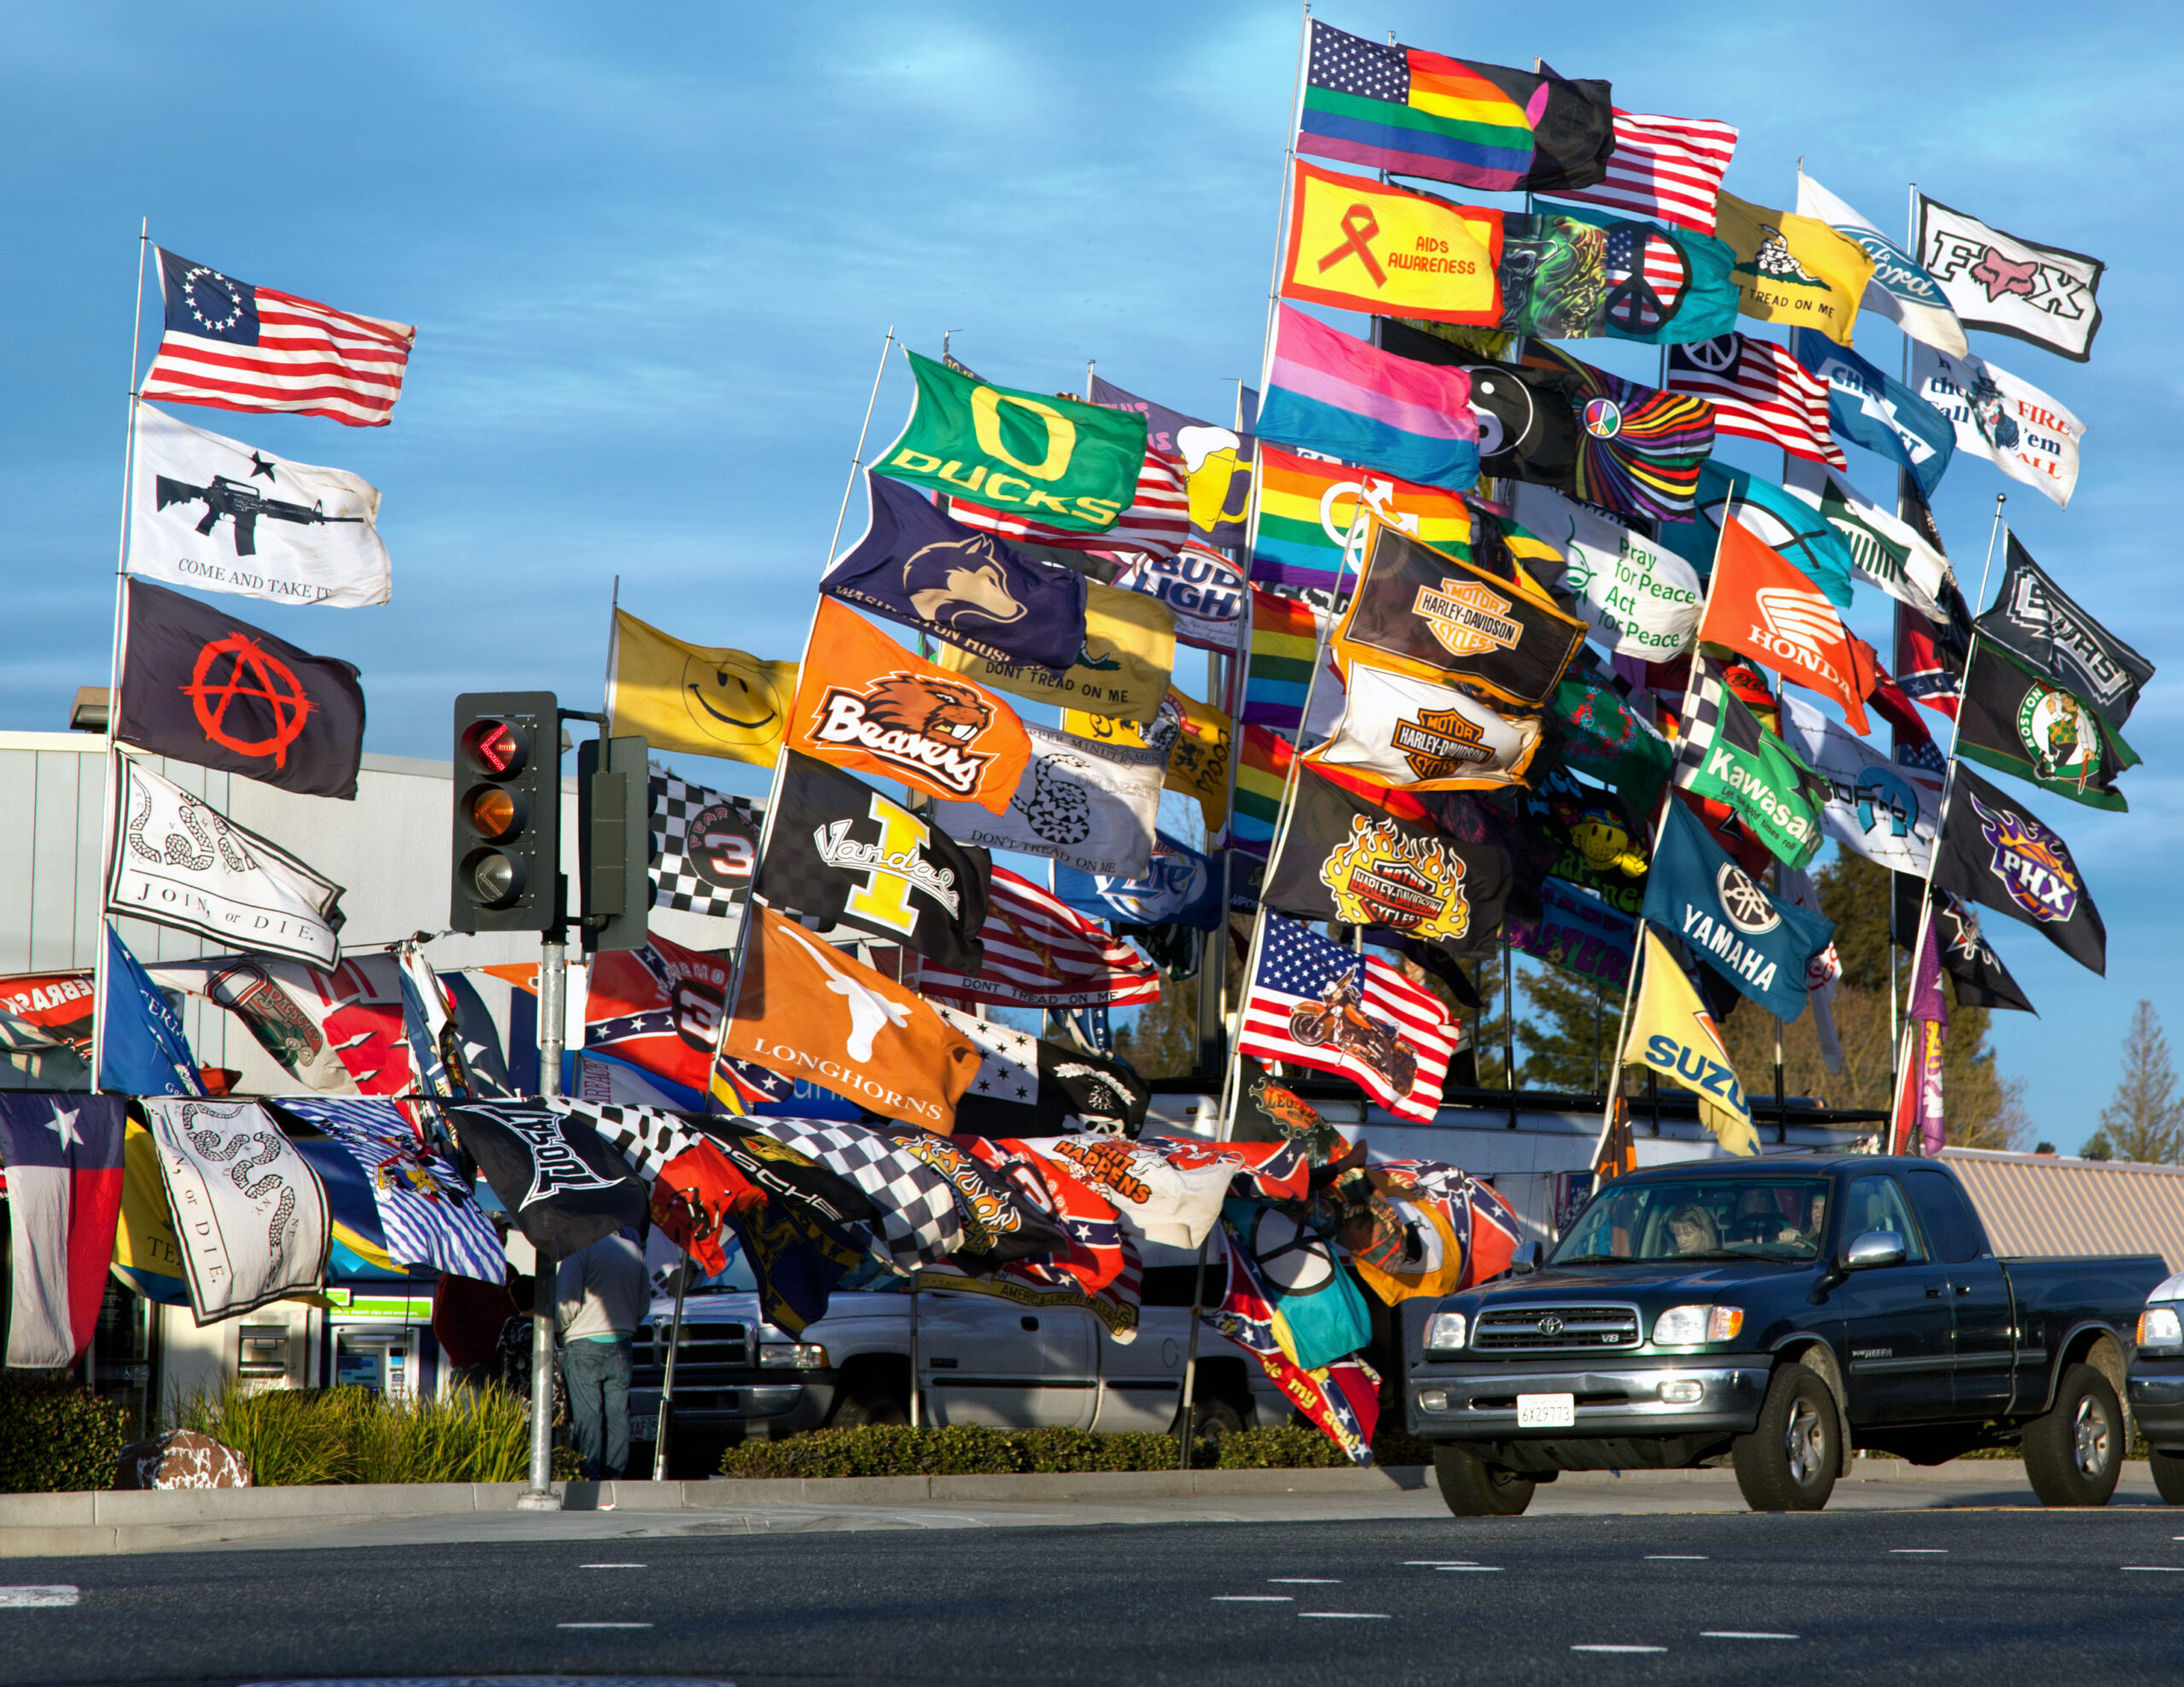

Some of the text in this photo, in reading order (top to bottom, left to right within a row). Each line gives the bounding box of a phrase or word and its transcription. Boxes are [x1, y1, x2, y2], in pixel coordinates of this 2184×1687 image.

[1387, 252, 1477, 275] AWARENESS
[1416, 236, 1449, 254] AIDS
[1749, 289, 1790, 308] TREAD
[1794, 299, 1814, 310] ON
[1817, 303, 1837, 319] ME
[1930, 401, 1971, 424] all
[2017, 398, 2073, 437] FIRE
[2023, 427, 2062, 456] 'em
[890, 448, 1122, 526] DUCKS
[1150, 554, 1243, 590] BUD
[1618, 536, 1658, 572] Pray
[178, 558, 333, 600] COME AND TAKE IT
[1449, 584, 1499, 614] MOTOR
[1615, 559, 1697, 606] for Peace
[1420, 592, 1514, 642] HARLEY-DAVIDSON
[1604, 585, 1637, 617] Act
[1438, 620, 1490, 650] CYCLES
[1597, 606, 1681, 648] for Peace
[985, 661, 1130, 704] DONT TREAD ON ME
[1745, 624, 1855, 704] HONDA
[1426, 714, 1476, 741] MOTOR
[2020, 687, 2043, 750] BOSTON
[820, 693, 985, 791] Beavers
[1071, 739, 1128, 766] MINUTE
[1398, 727, 1490, 762] HARLEY-DAVIDSON
[690, 806, 729, 848] FEAR
[1744, 801, 1763, 821] good
[1760, 819, 1781, 841] times
[703, 832, 756, 878] 3
[971, 828, 1117, 873] DON'T TREAD ON ME
[1350, 870, 1442, 915] HARLEY-DAVIDSON
[1382, 866, 1428, 891] MOTOR
[2001, 849, 2072, 912] PHX
[136, 883, 314, 942] JOIN, or DIE.
[1681, 902, 1779, 993] YAMAHA
[962, 977, 1119, 1006] DONT TREAD ON ME
[752, 1036, 944, 1122] LONGHORNS
[1052, 1140, 1153, 1204] HAPPENS
[1090, 1141, 1137, 1173] SHIT
[184, 1189, 226, 1284] or DIE.
[1600, 1333, 1620, 1344] V8
[1287, 1377, 1318, 1410] my
[1322, 1409, 1362, 1451] day!
[1522, 1406, 1571, 1423] 6X29773
